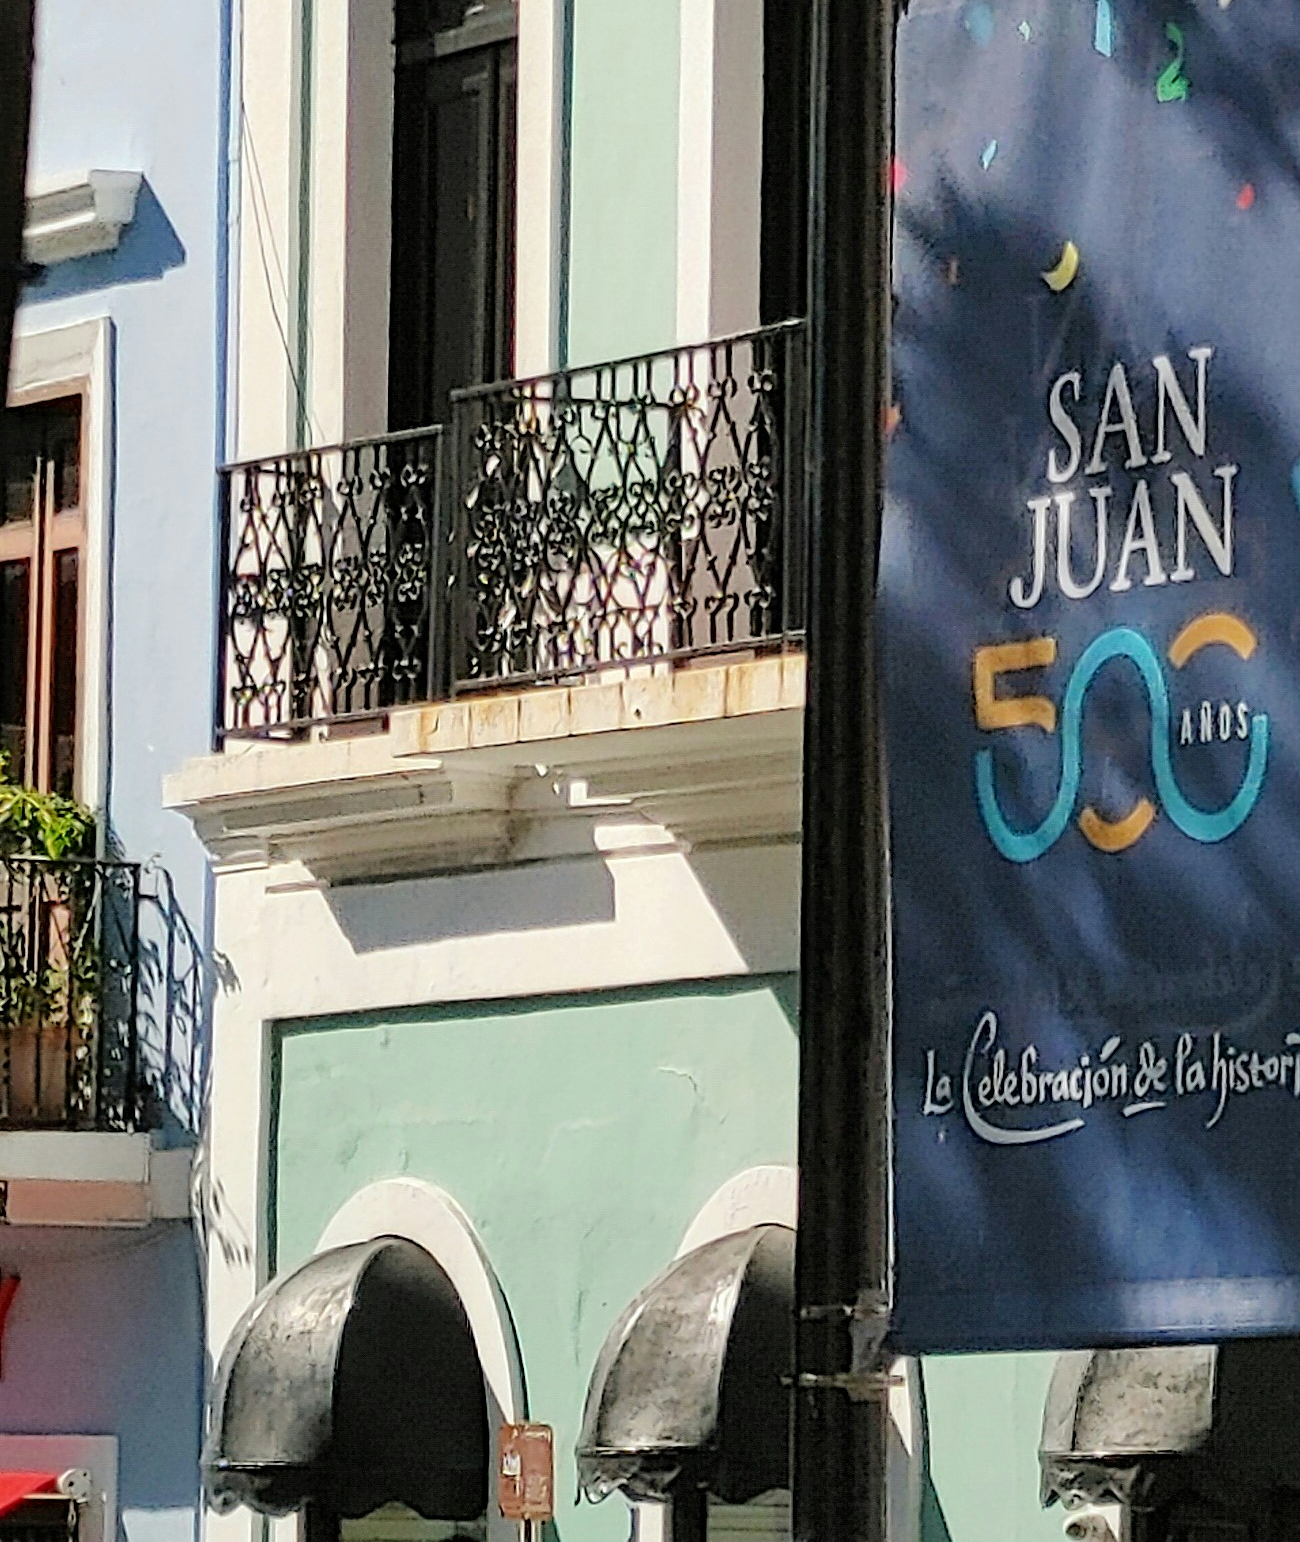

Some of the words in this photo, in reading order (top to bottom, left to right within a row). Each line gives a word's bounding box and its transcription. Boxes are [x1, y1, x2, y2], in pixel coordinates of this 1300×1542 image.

[1047, 347, 1214, 484] SAN
[1009, 464, 1239, 608] JUAN
[972, 613, 1268, 862] 500
[1179, 701, 1249, 744] AÑOS
[922, 1049, 952, 1116] La
[962, 1011, 1128, 1144] Celebración
[1126, 1041, 1167, 1111] de
[1174, 1032, 1205, 1095] la
